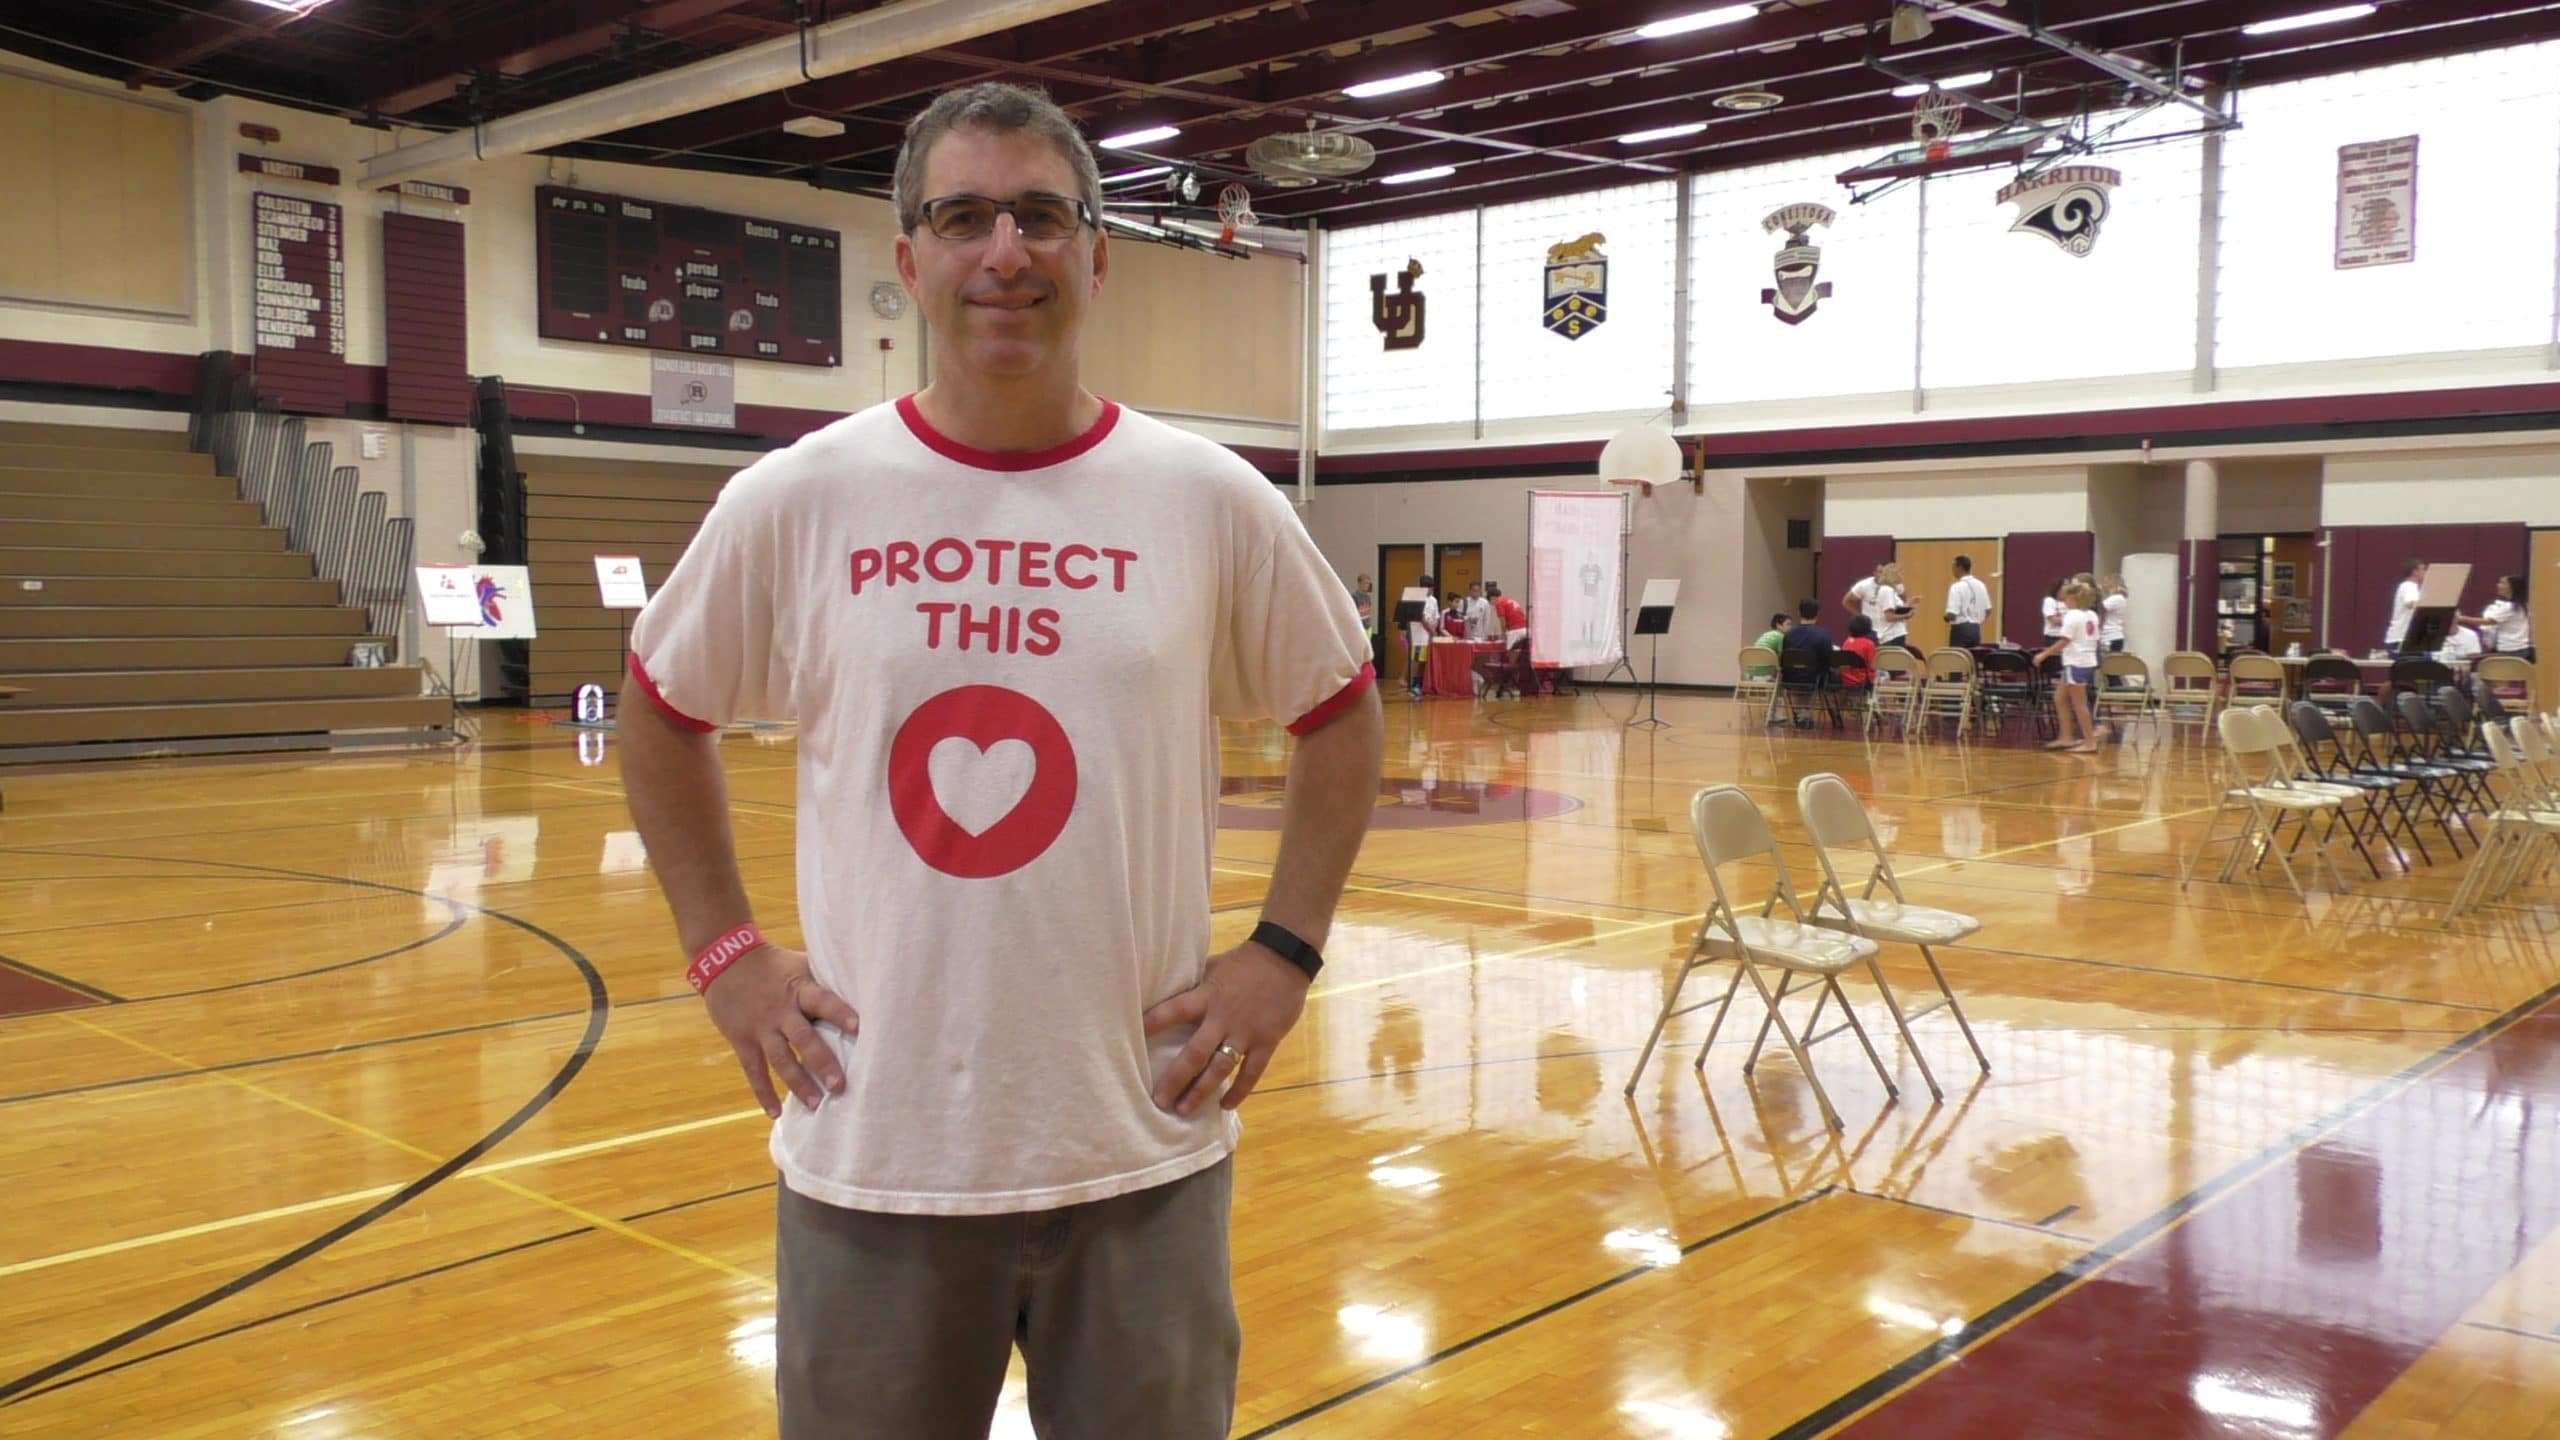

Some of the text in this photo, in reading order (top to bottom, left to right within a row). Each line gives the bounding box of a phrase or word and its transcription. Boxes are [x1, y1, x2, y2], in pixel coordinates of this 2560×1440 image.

[1568, 319, 1580, 335] S
[850, 537, 1138, 595] PROTECT
[916, 602, 1062, 656] THIS
[698, 929, 755, 976] FUND
